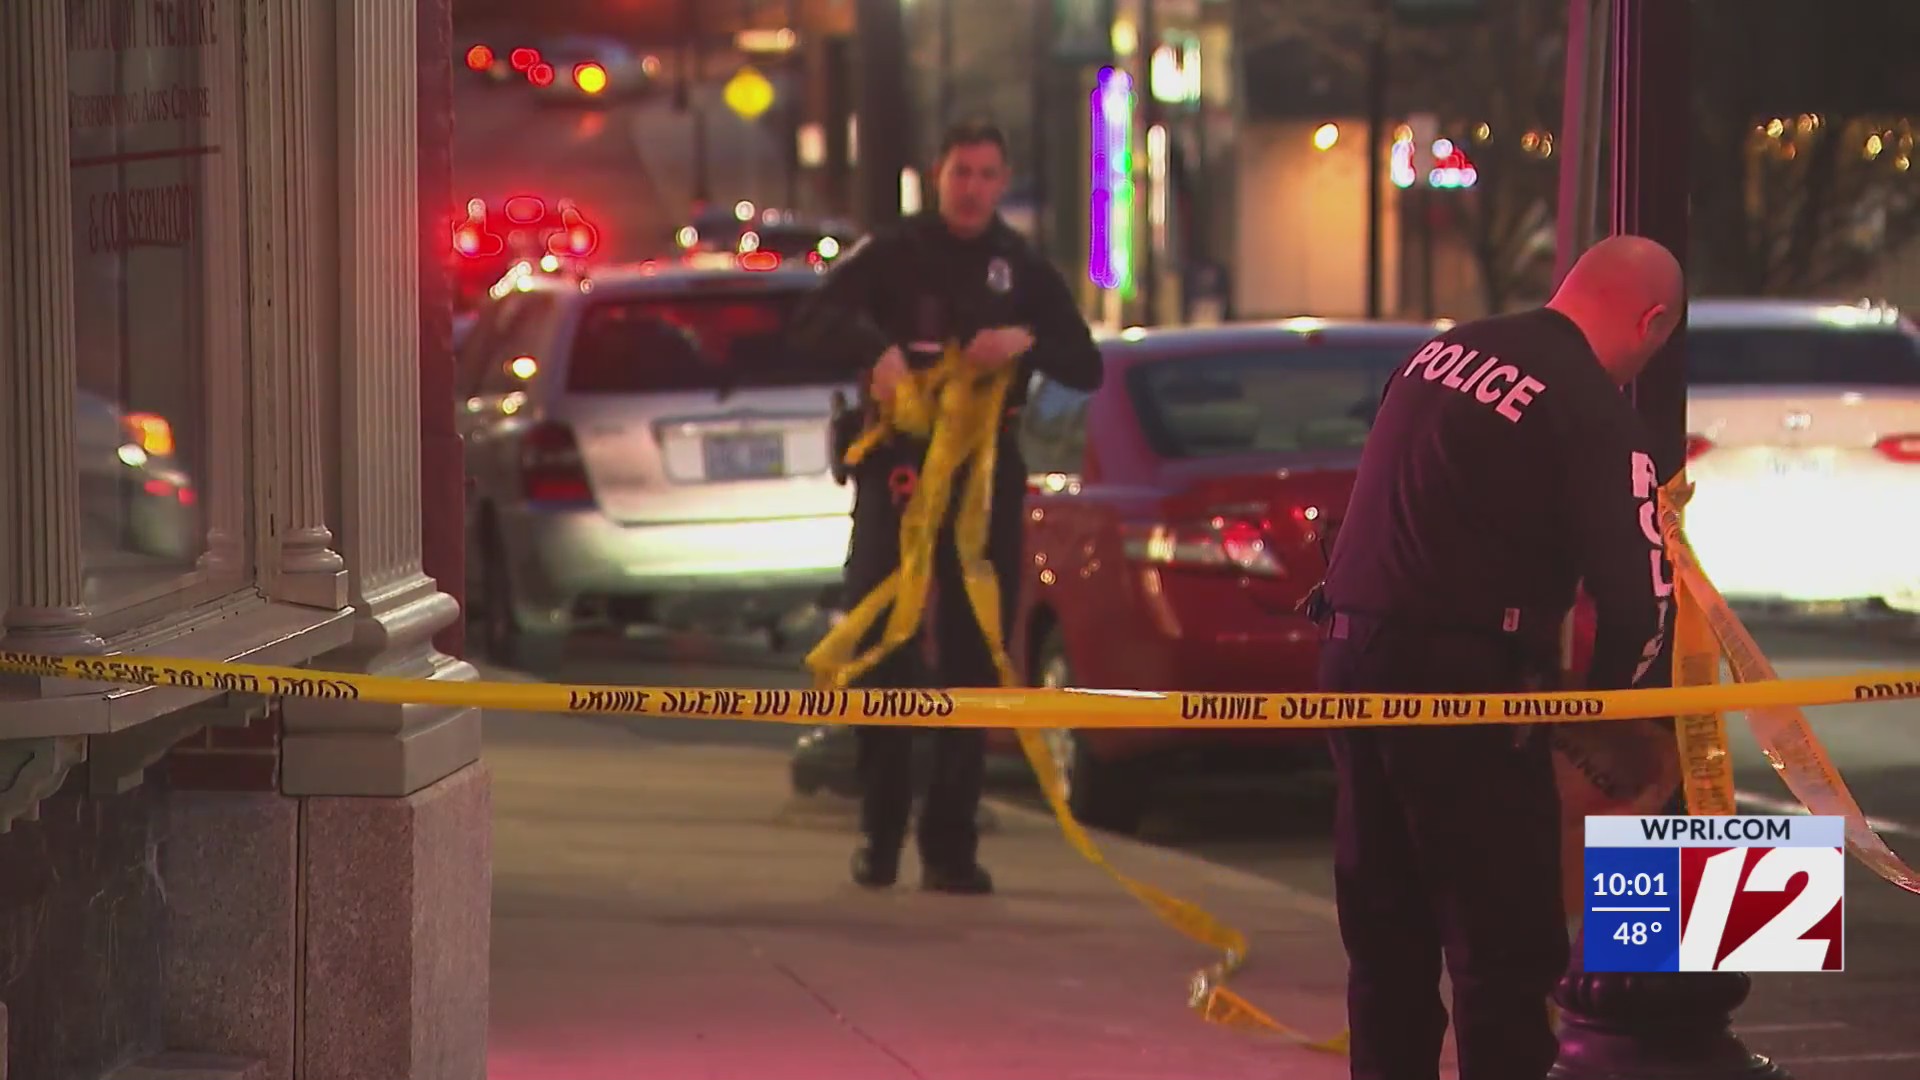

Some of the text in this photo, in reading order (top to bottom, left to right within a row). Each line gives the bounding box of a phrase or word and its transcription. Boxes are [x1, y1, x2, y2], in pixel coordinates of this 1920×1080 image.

[1403, 341, 1546, 423] POLICE
[569, 690, 649, 712] CRIME
[661, 691, 746, 715] SCENE
[798, 690, 848, 717] NOT
[863, 690, 954, 717] CROSS
[1181, 695, 1268, 720] CRIME
[1281, 697, 1372, 720] SCENE
